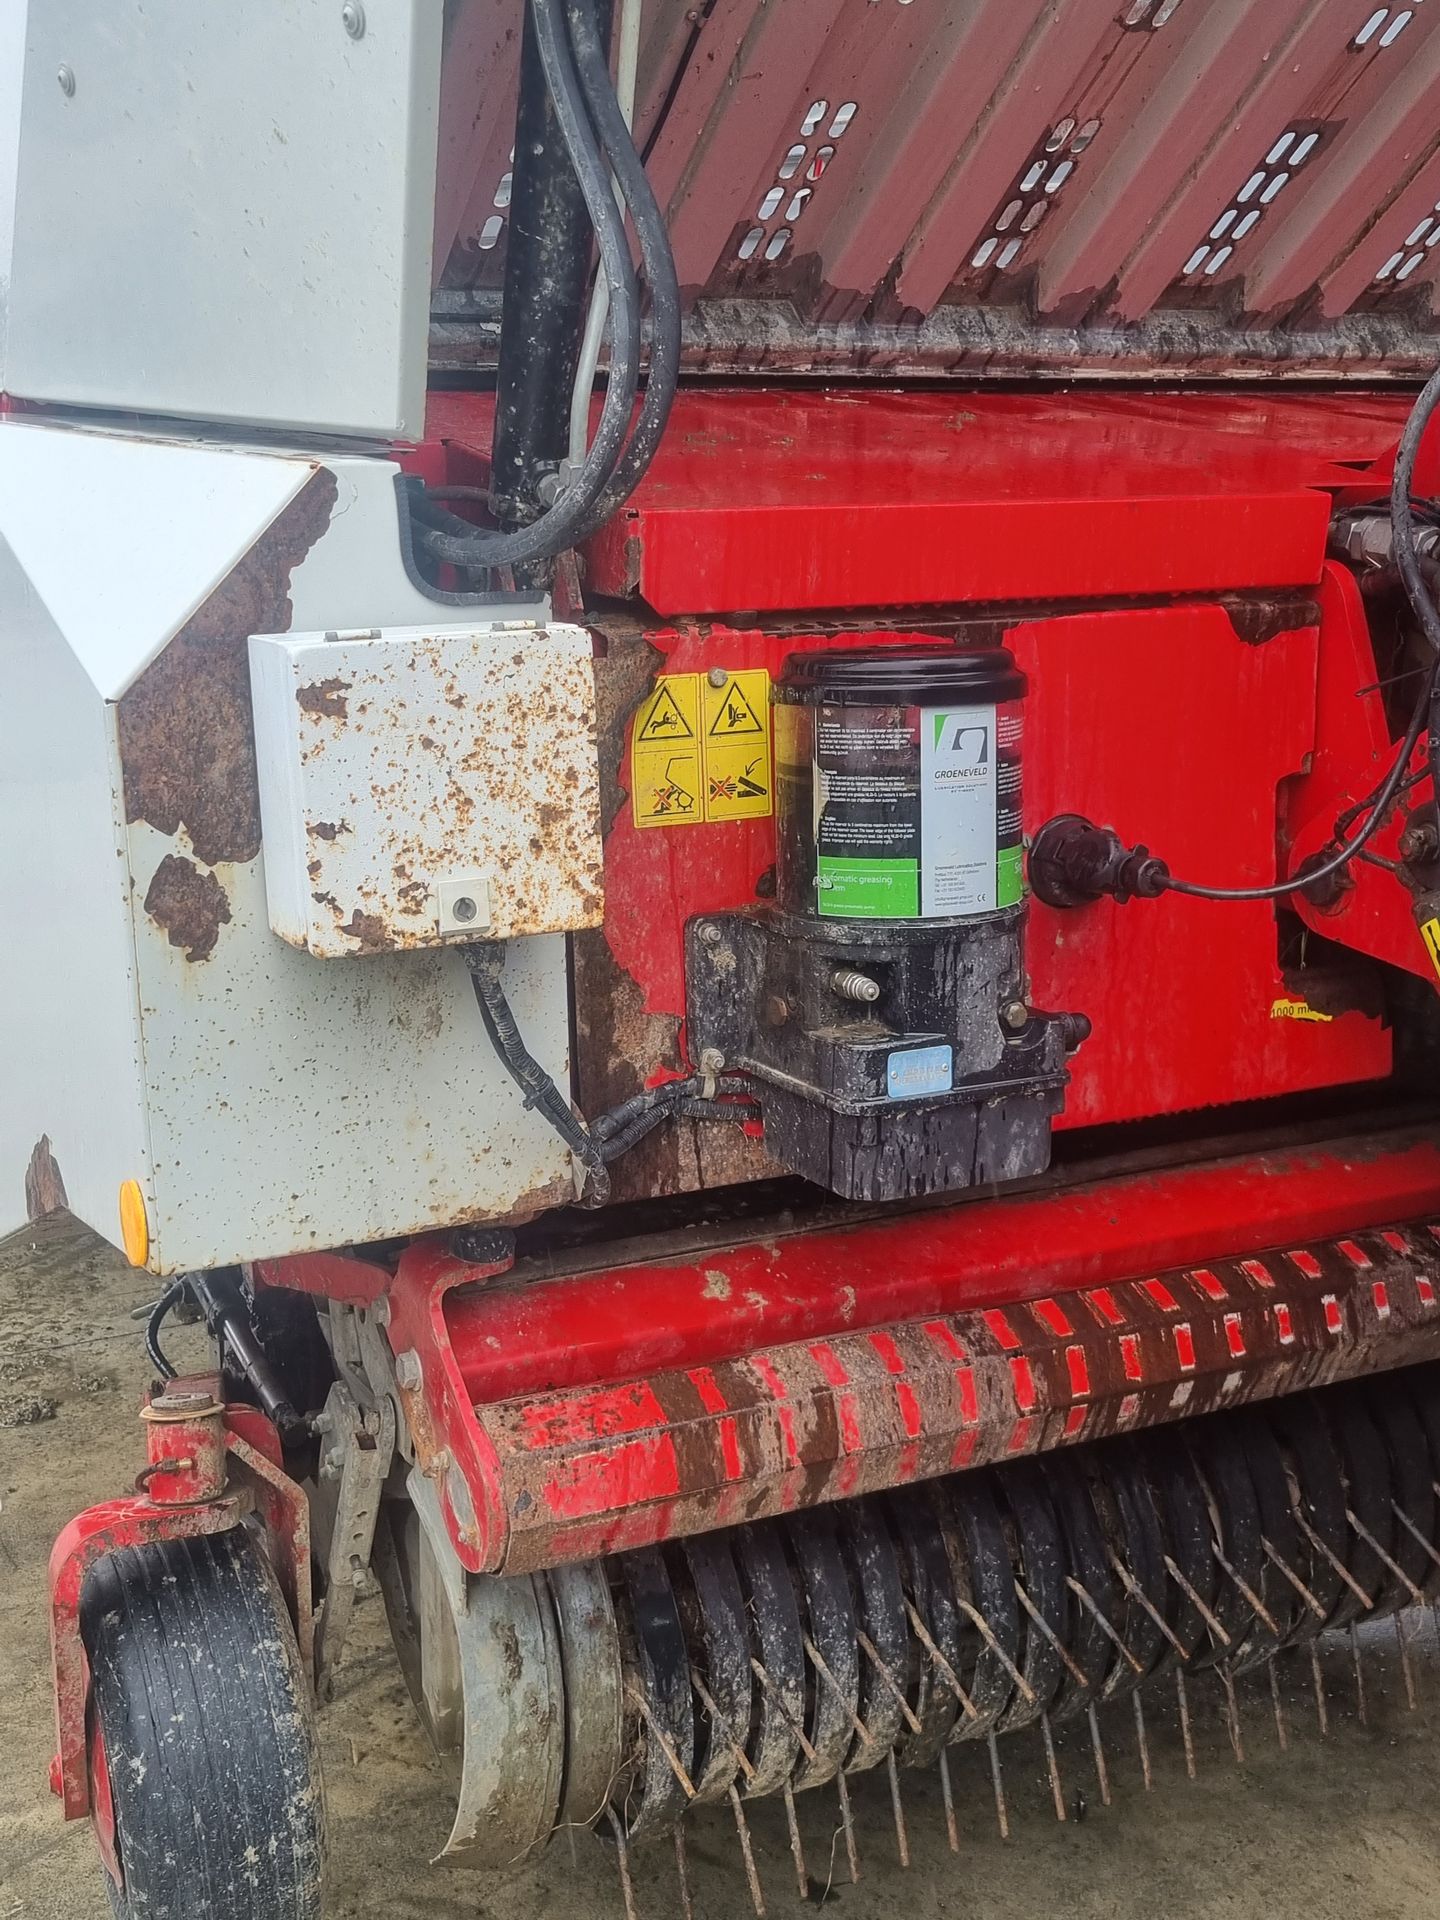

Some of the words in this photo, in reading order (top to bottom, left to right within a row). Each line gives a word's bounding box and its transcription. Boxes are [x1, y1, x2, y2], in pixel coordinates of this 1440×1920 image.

[934, 767, 988, 779] GROENEVELD
[859, 875, 893, 886] greasing
[1272, 1005, 1295, 1017] 1000
